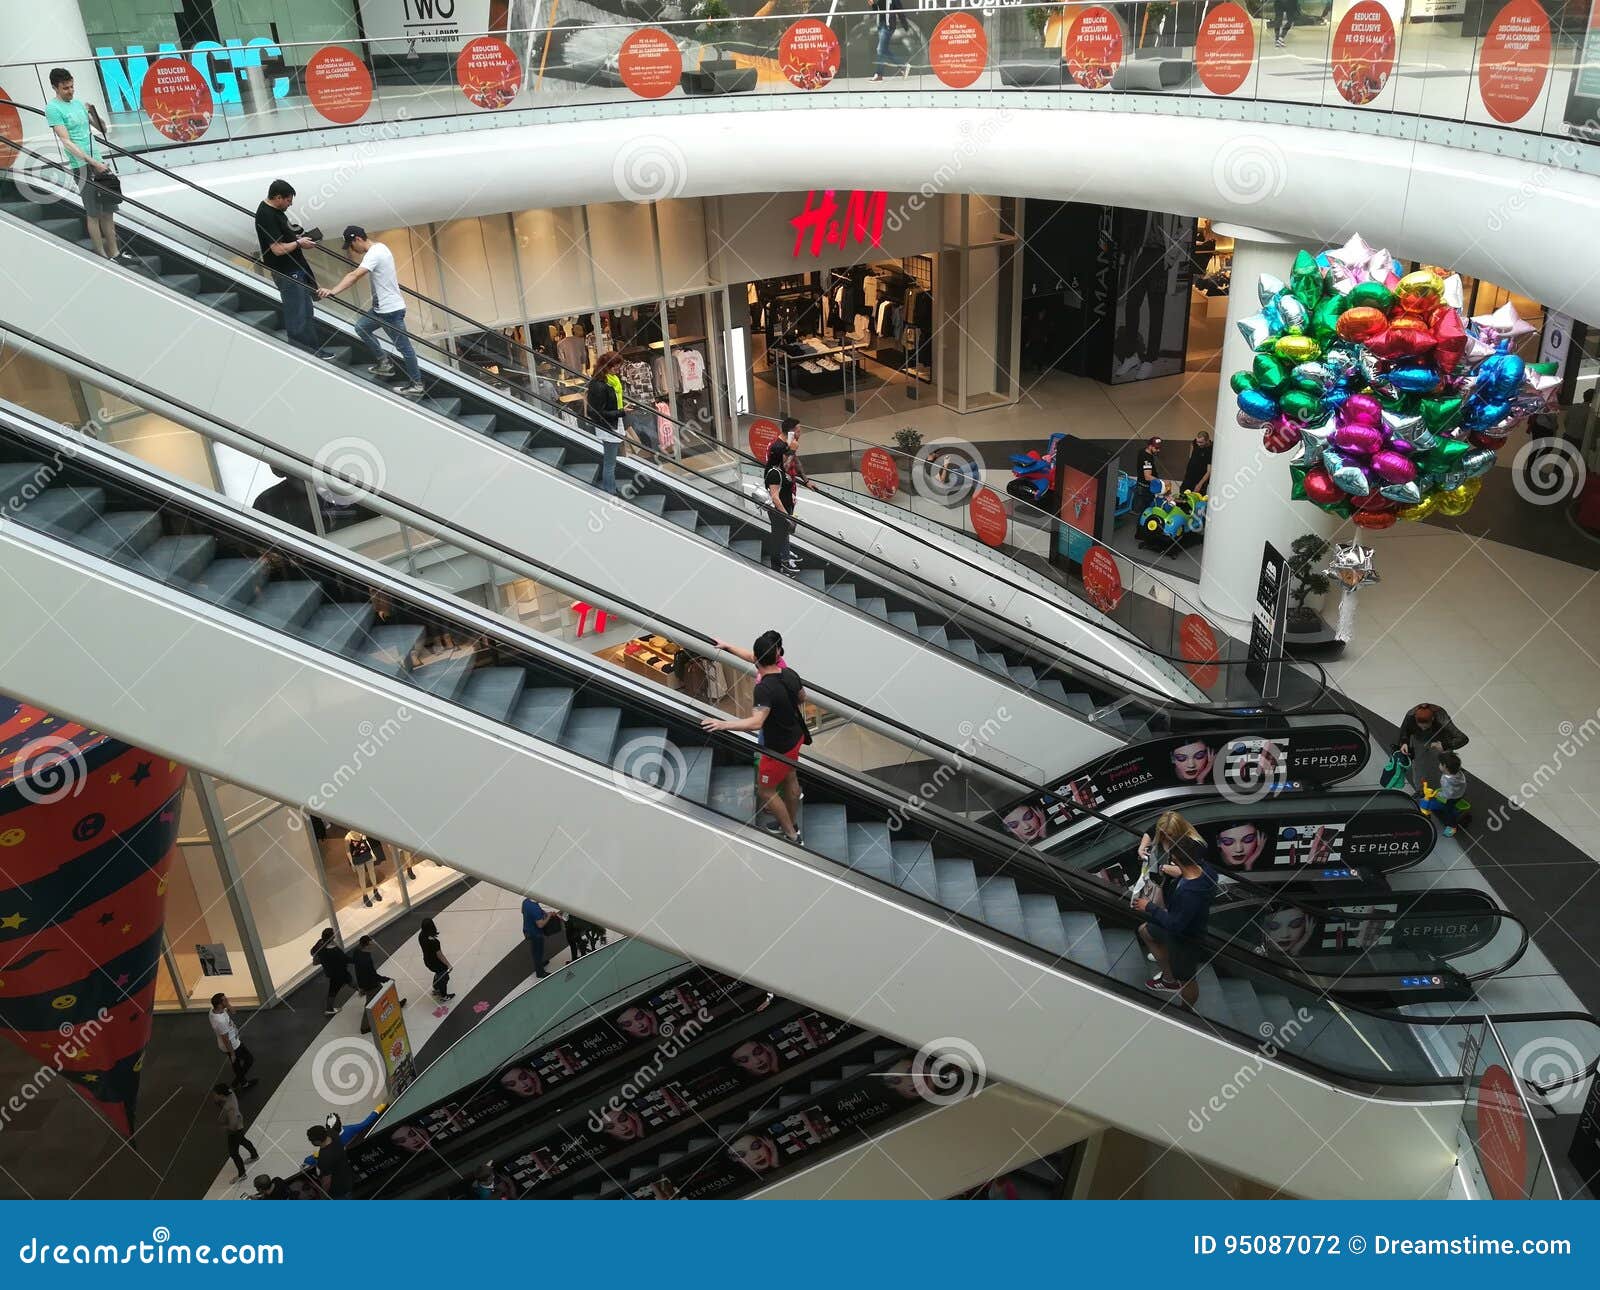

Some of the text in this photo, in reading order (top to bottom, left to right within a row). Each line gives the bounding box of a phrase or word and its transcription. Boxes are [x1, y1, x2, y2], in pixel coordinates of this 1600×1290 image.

[1082, 16, 1107, 24] REDUCERI
[1354, 12, 1381, 20] REDUCERI
[795, 27, 822, 35] REDUCERI
[1081, 25, 1108, 33] EXCLUSIVE
[1351, 24, 1382, 32] EXCLUSIVE
[794, 34, 824, 43] EXCLUSIVE
[472, 45, 499, 53] REDUCERI
[471, 52, 502, 60] EXCLUSIVE
[157, 66, 186, 76] REDUCERI
[157, 75, 190, 85] EXCLUSIVE
[789, 190, 889, 258] H&M
[1294, 754, 1357, 766] SEPHORA
[1106, 772, 1153, 794] SEPHORA
[1350, 841, 1420, 853] SEPHORA
[1402, 923, 1480, 936] SEPHORA
